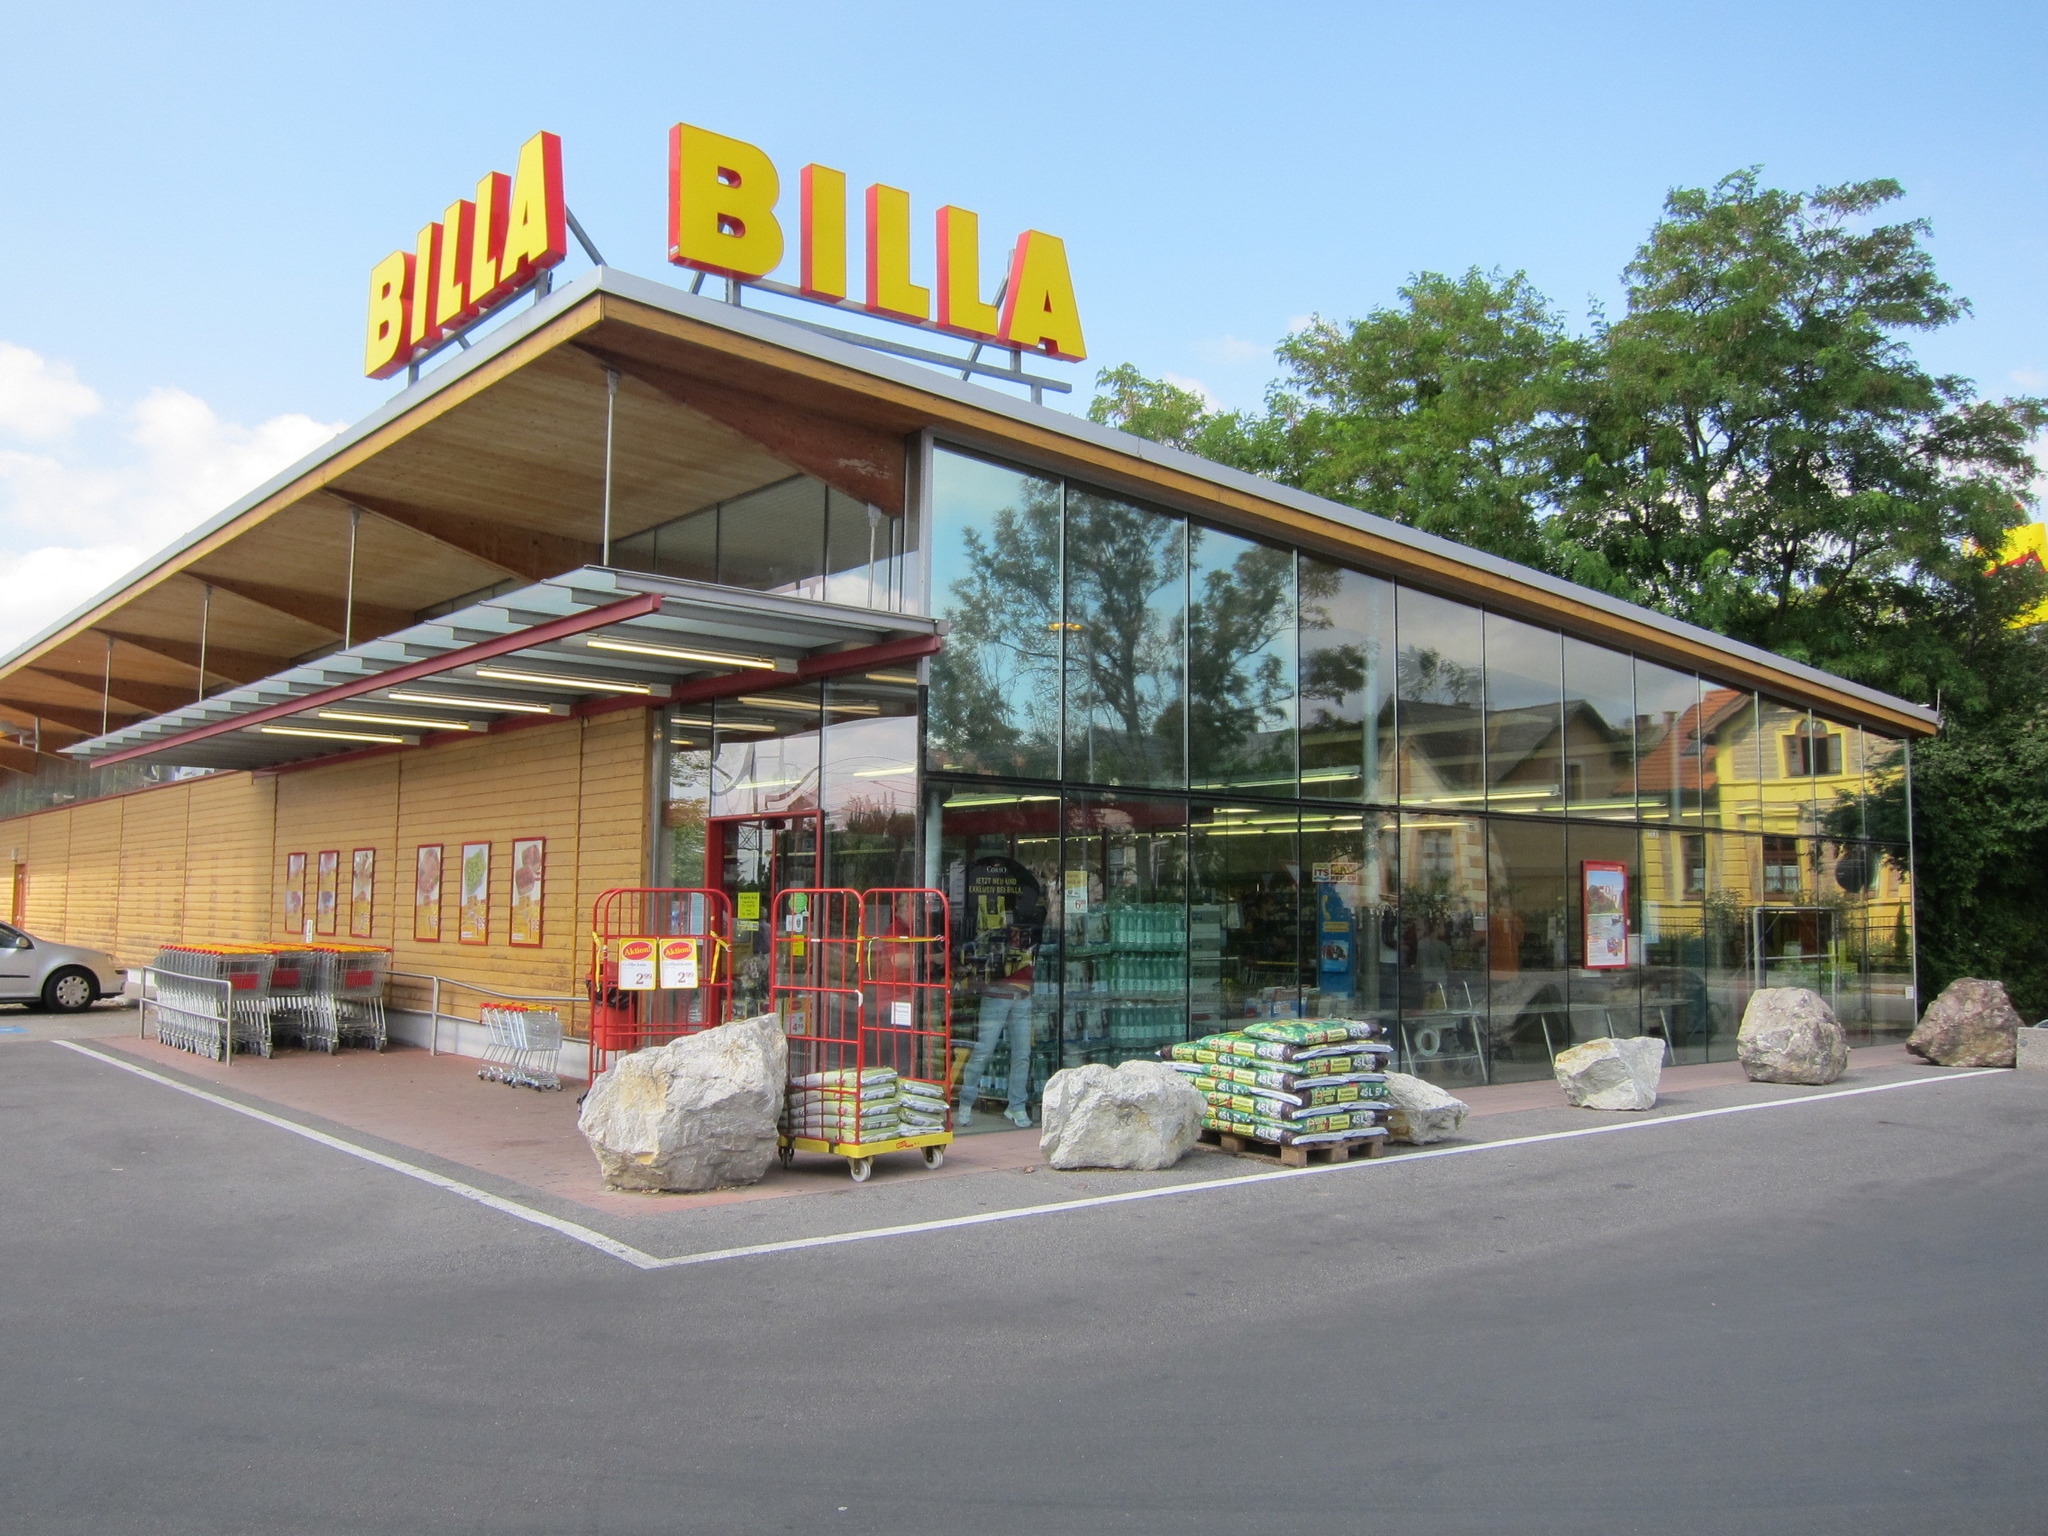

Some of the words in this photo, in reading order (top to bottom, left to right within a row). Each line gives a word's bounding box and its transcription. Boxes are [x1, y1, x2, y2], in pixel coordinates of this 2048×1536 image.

[669, 122, 1088, 362] BILLA
[364, 130, 567, 380] BILLA
[975, 877, 991, 885] JETZT
[992, 877, 1004, 885] NEU
[624, 944, 652, 956] Aktion!
[665, 945, 692, 957] Aktion!
